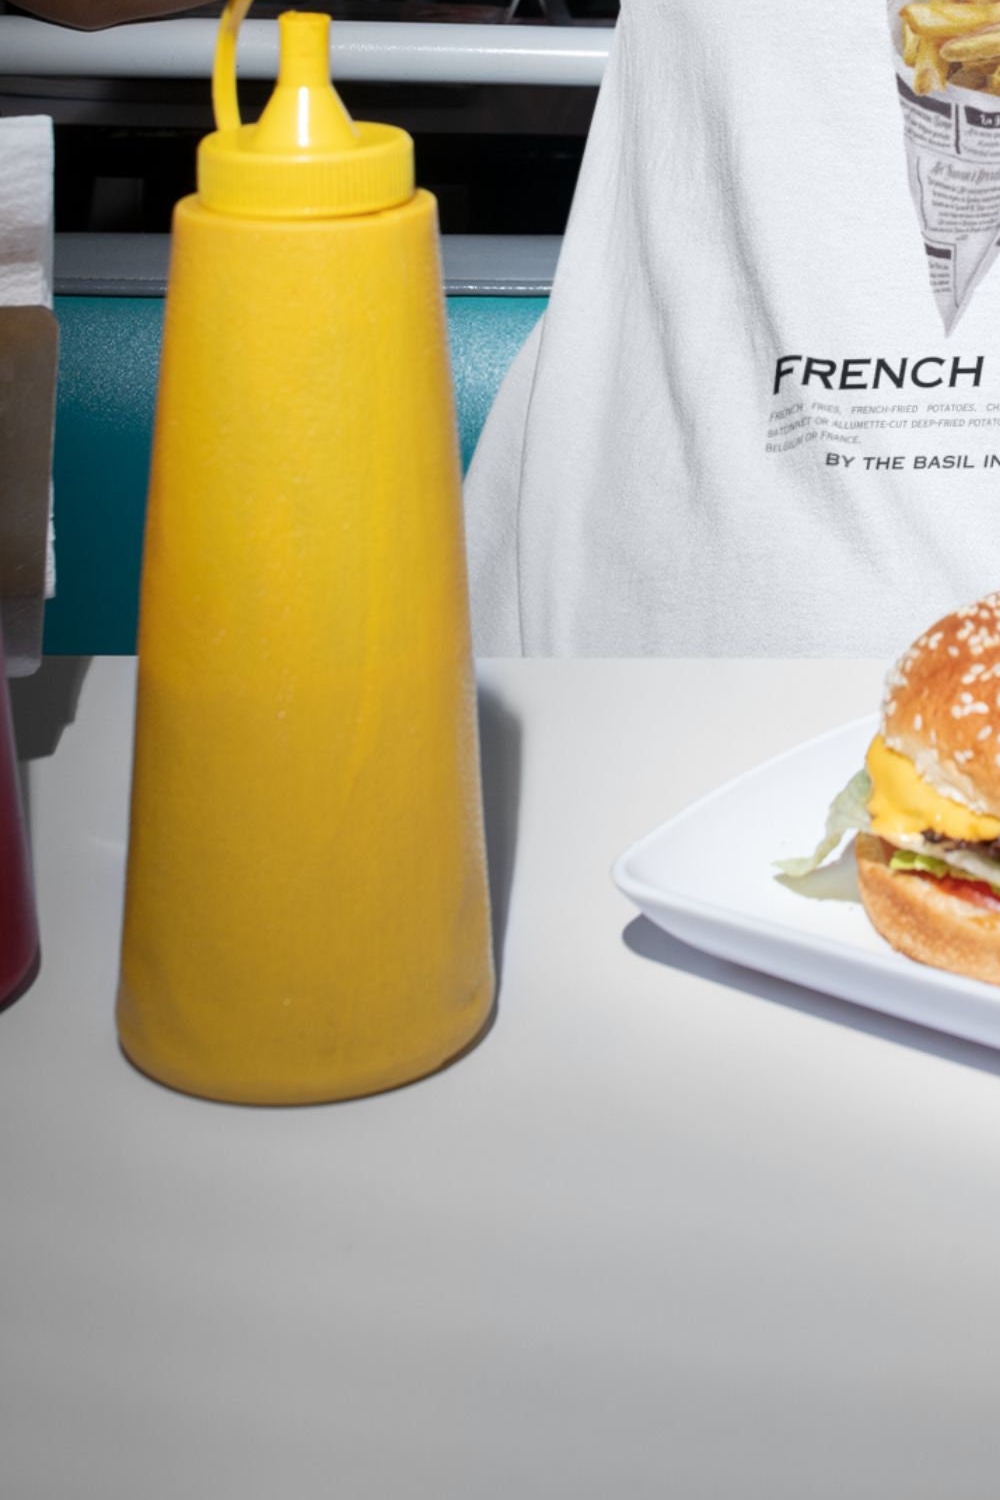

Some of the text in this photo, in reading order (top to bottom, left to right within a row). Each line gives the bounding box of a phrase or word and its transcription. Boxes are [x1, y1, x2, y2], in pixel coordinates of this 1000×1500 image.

[773, 354, 985, 395] FRENCH
[769, 402, 803, 422] FRENCH
[851, 404, 918, 415] FRENCH-FRIED
[814, 416, 829, 425] OR
[832, 419, 908, 430] ALLUMETTE-CUT
[911, 418, 965, 429] DEEP-FRIED
[825, 452, 855, 468] BY
[863, 456, 906, 471] THE
[913, 455, 975, 470] BASIL
